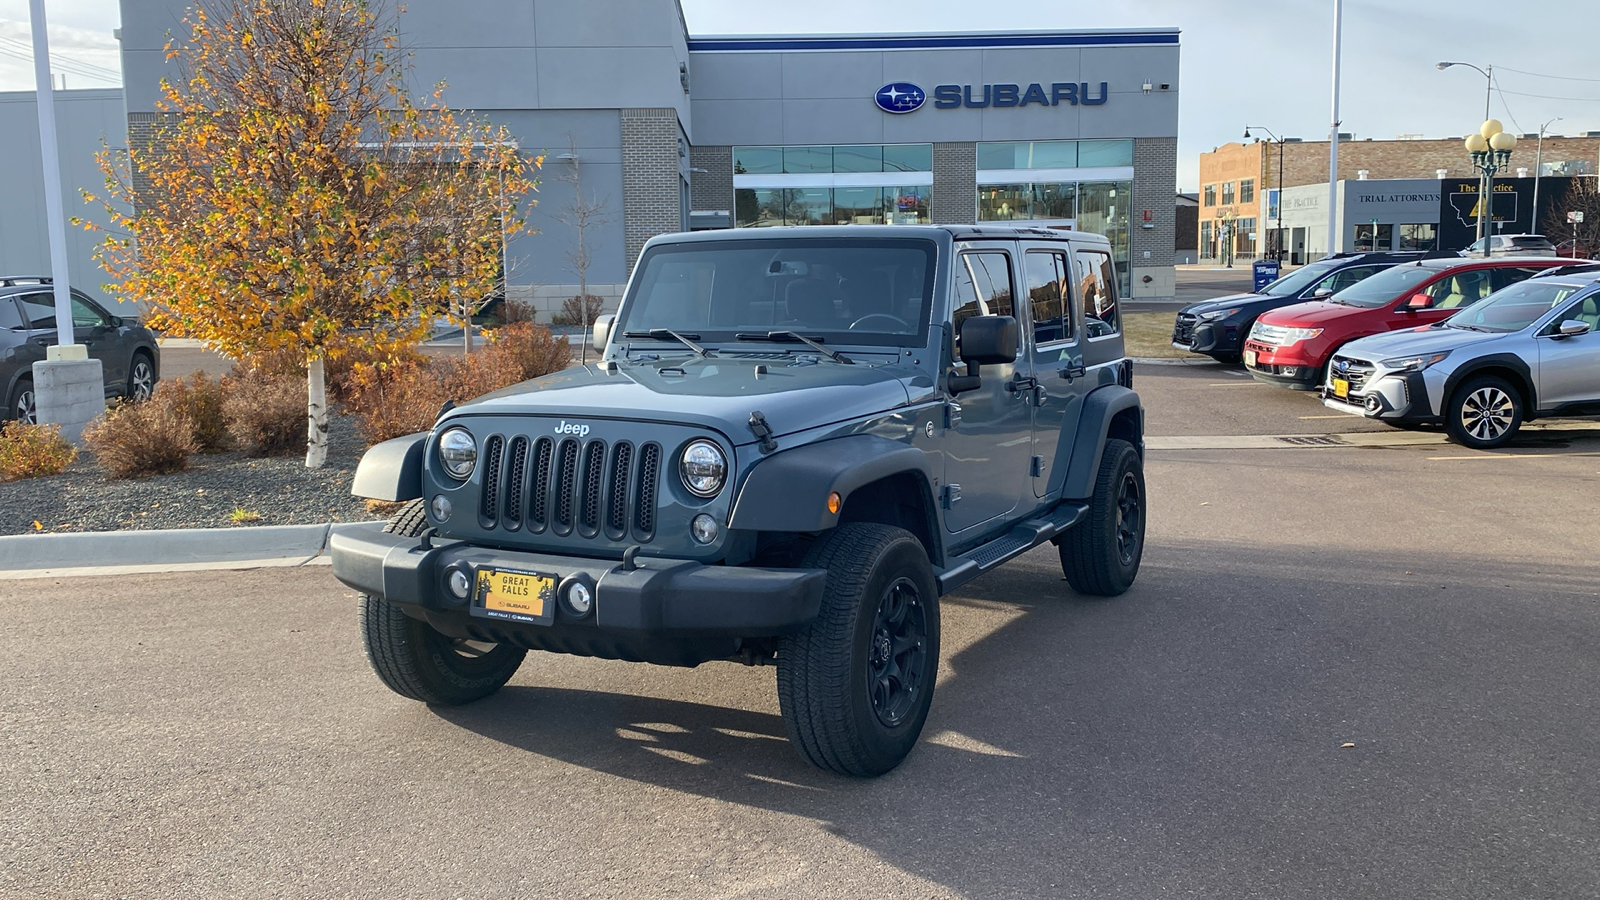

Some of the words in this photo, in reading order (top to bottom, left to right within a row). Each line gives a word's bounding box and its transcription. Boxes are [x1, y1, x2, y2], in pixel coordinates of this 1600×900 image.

[934, 82, 1108, 109] SUBARU
[1458, 184, 1476, 192] The
[1294, 197, 1318, 208] PRACTICE
[1359, 195, 1387, 203] TRIAL
[1388, 194, 1440, 202] ATTORNEYS
[554, 420, 590, 438] Jeep
[502, 576, 530, 587] GREAT
[501, 585, 529, 596] FALLS
[505, 602, 530, 610] SUBARU
